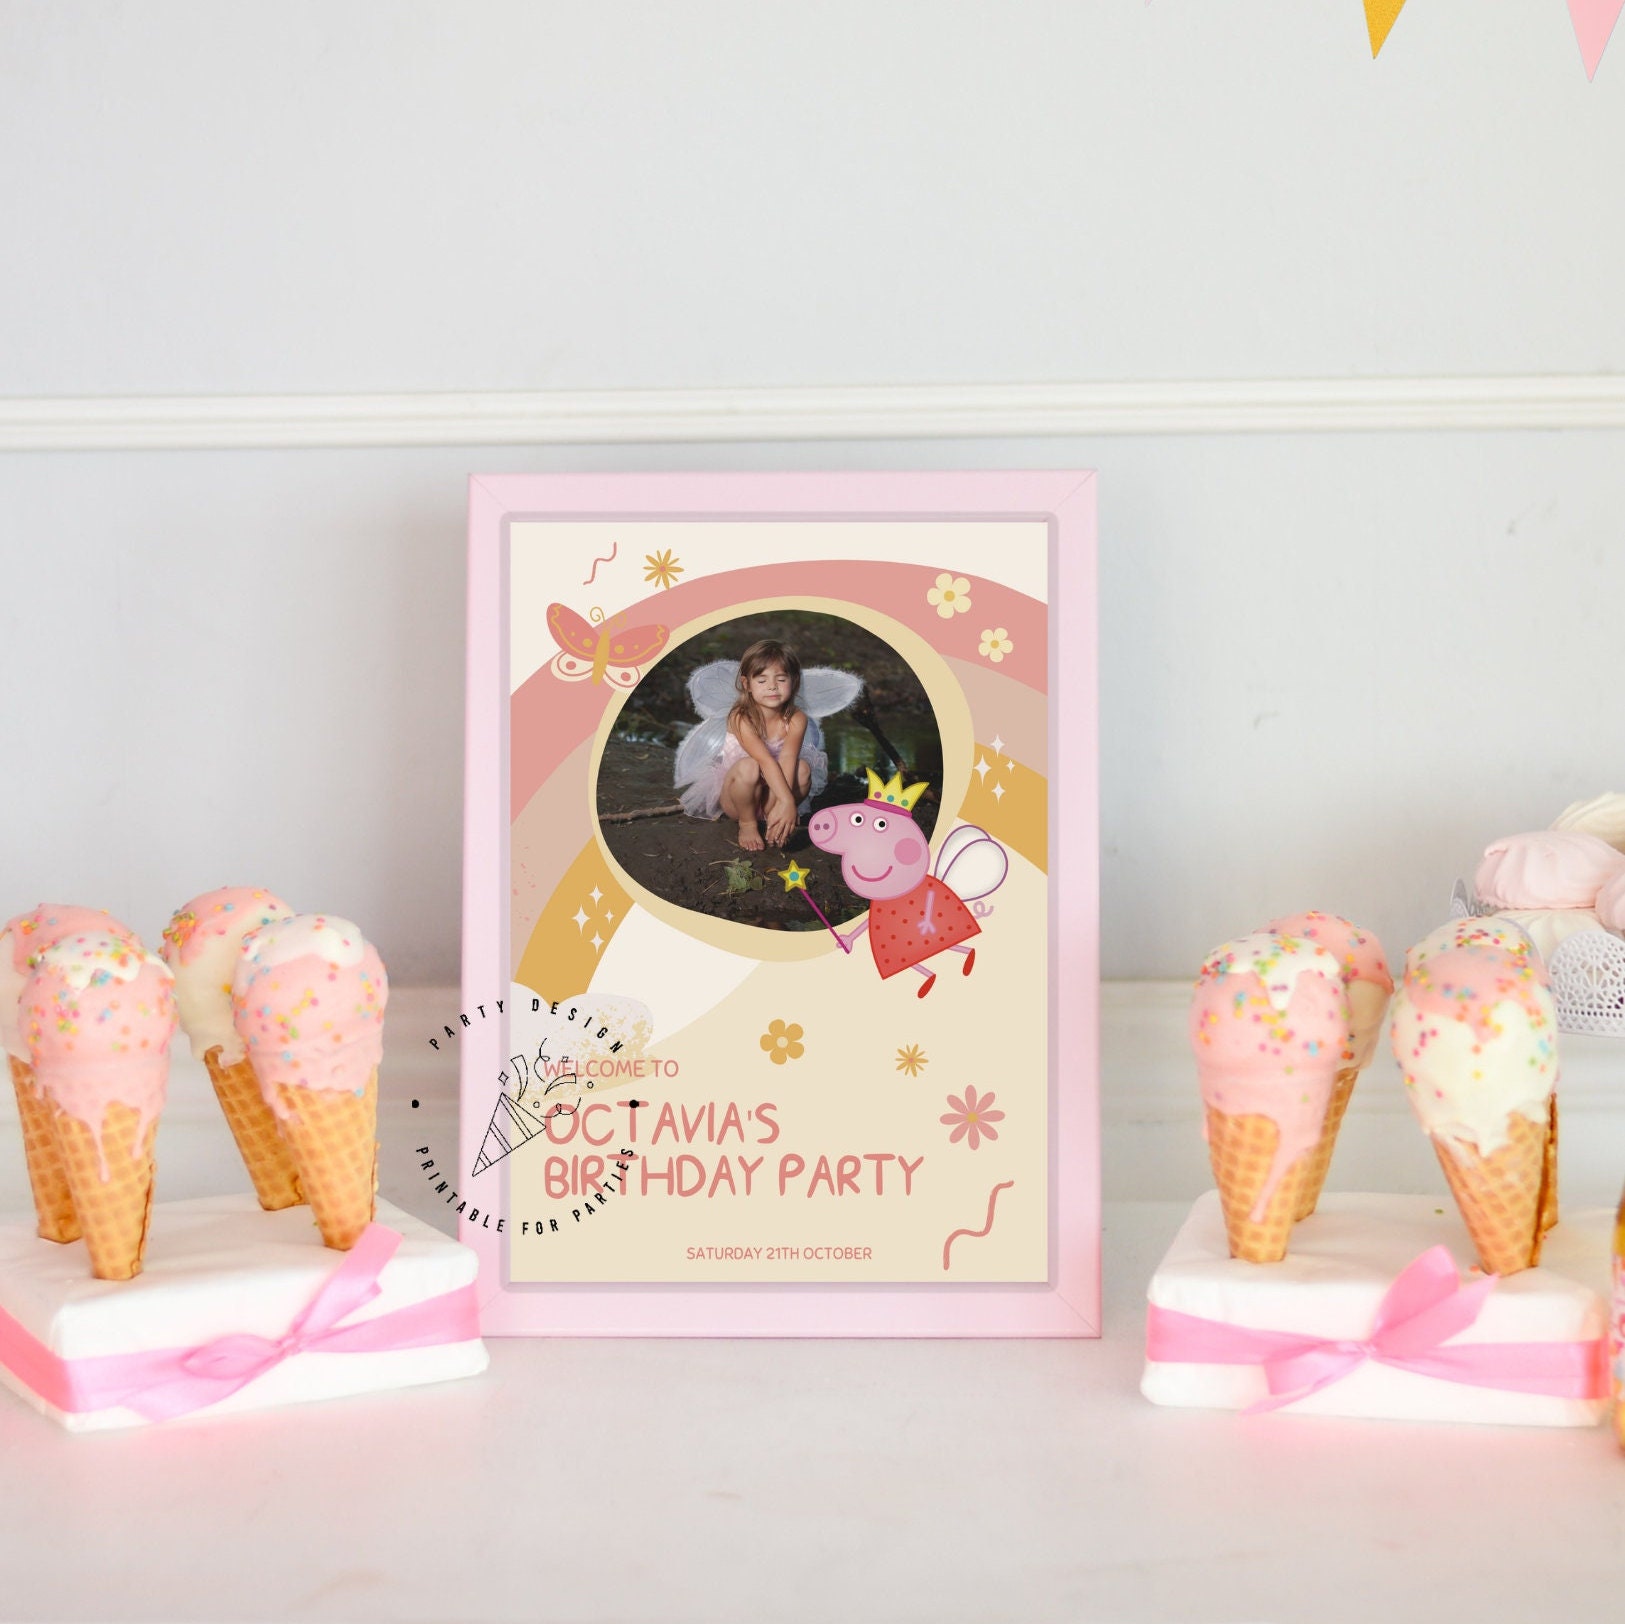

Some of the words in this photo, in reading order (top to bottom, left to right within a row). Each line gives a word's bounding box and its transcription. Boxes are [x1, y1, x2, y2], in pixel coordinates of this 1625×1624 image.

[543, 1059, 645, 1078] WELCOME
[651, 1059, 679, 1078] TO
[544, 1101, 780, 1146] OCTAVIA'S
[544, 1153, 764, 1199] BIRTHDAY
[778, 1153, 924, 1198] PARTY
[686, 1246, 763, 1260] SATURDAY
[766, 1246, 799, 1260] 21TH
[803, 1246, 872, 1260] OCTOBER
